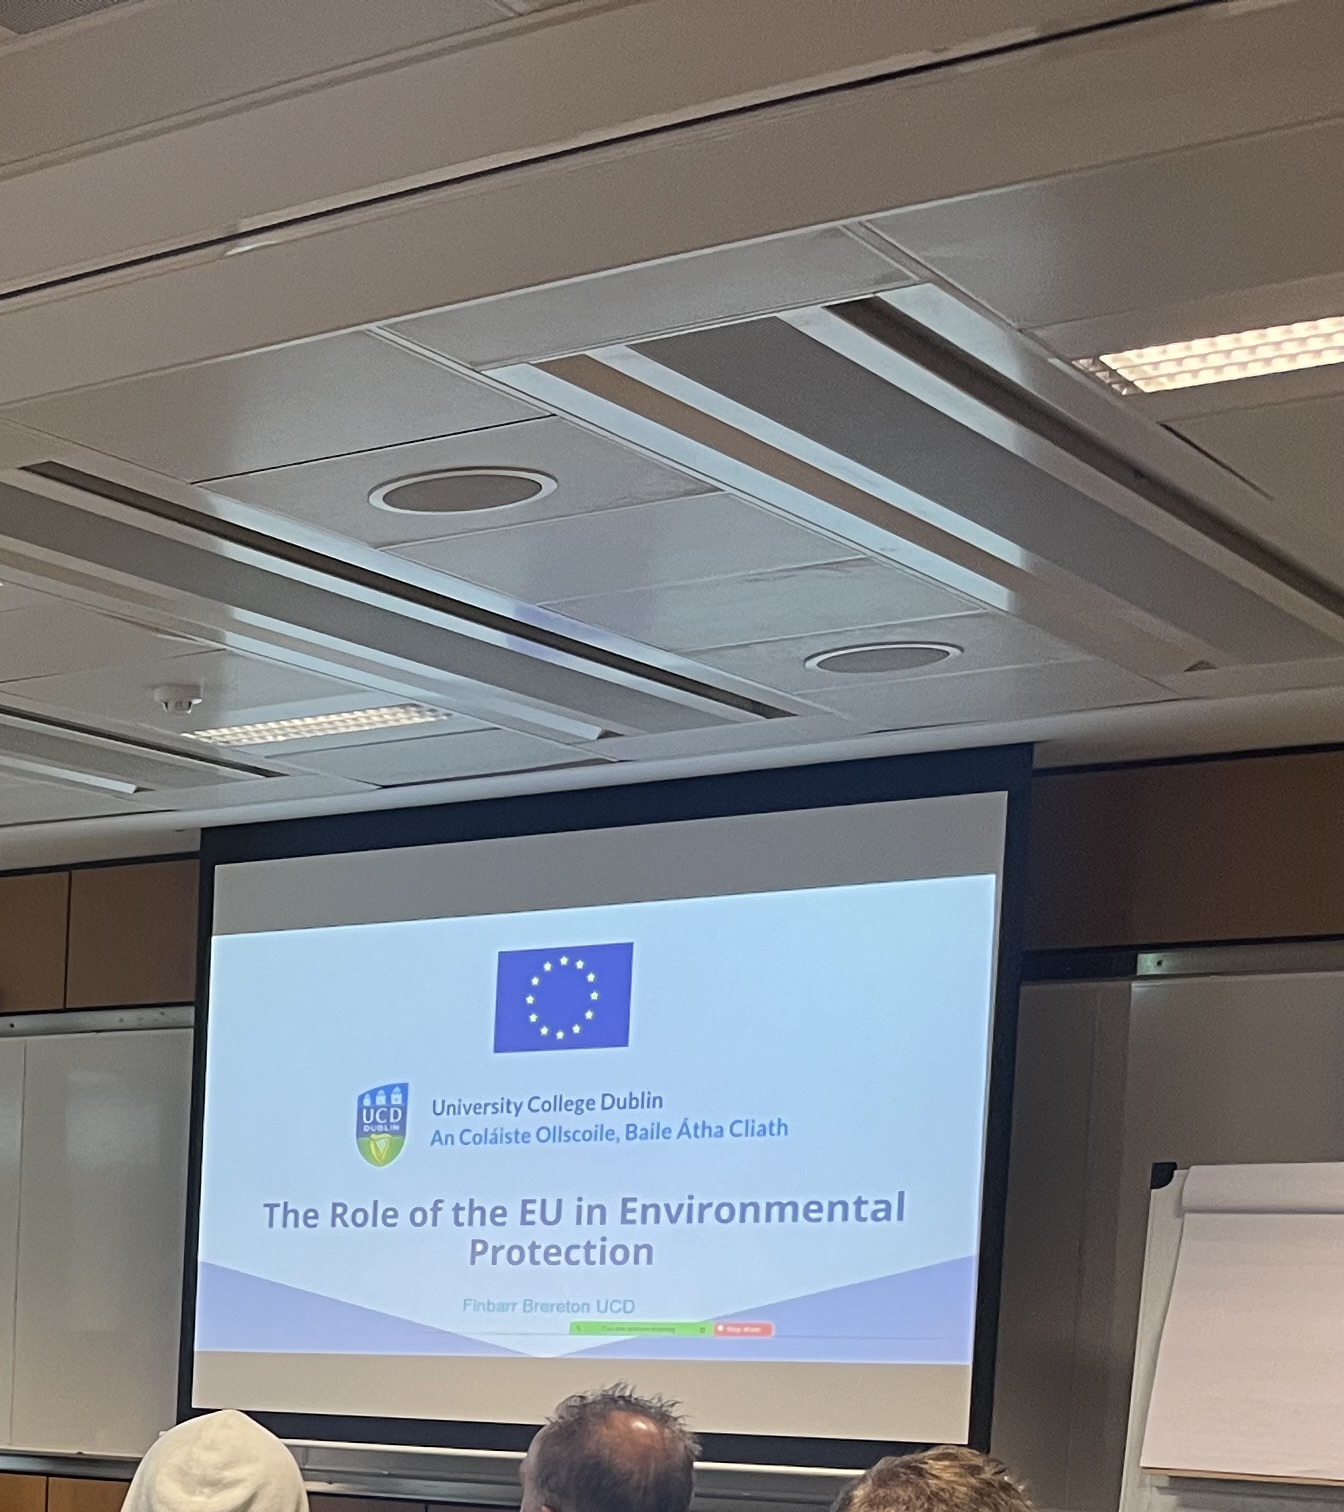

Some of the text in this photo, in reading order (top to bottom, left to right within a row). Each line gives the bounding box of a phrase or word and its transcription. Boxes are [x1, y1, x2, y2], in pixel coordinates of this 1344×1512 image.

[362, 1107, 403, 1124] UCD
[431, 1090, 664, 1117] University College Dublin
[430, 1117, 789, 1147] An Coláiste Ollscoile, Baile Átha Cliath
[263, 1190, 906, 1229] The Role of the EU in Environmental
[469, 1236, 655, 1266] Protection
[462, 1298, 636, 1314] Finbarr Brereton UCD
